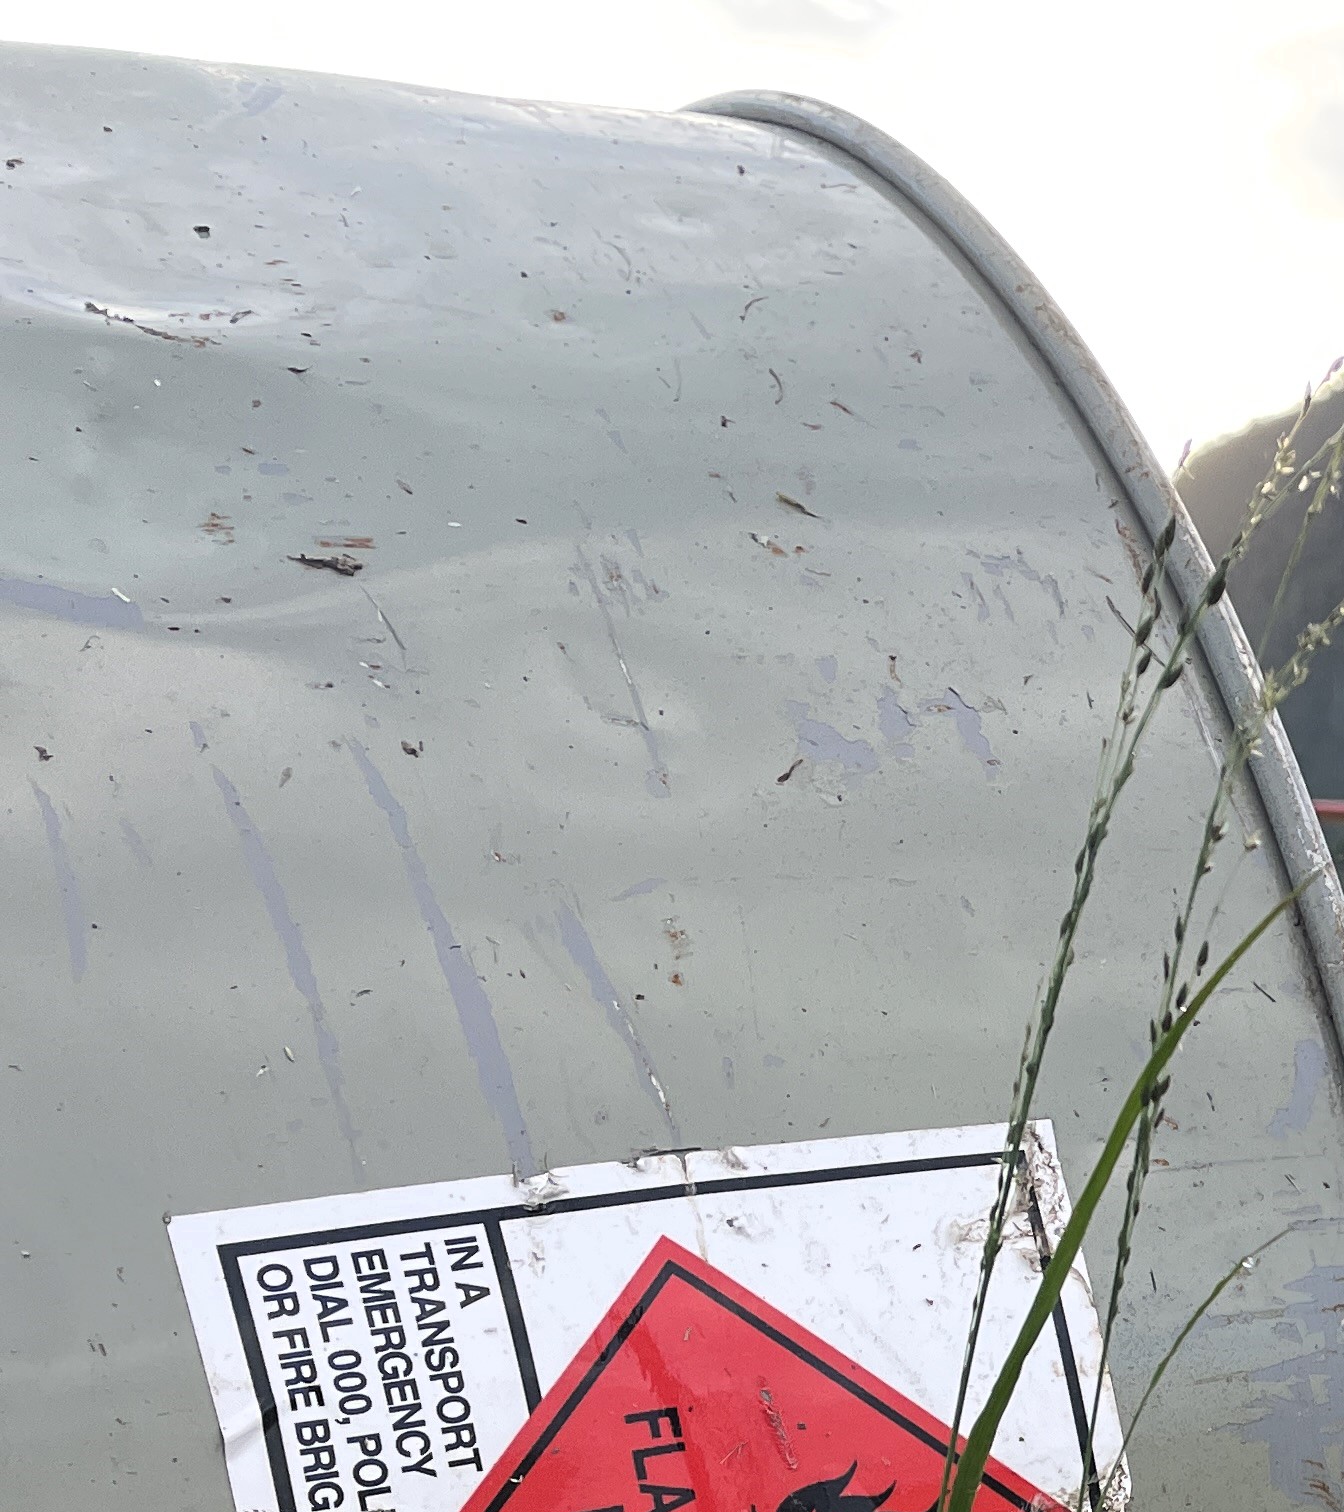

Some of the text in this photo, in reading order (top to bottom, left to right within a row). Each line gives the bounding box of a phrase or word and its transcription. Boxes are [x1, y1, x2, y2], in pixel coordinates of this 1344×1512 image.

[256, 1263, 300, 1320] OR
[444, 1236, 490, 1308] IN A
[272, 1328, 325, 1411] FIRE
[302, 1256, 354, 1344] DIAL
[328, 1350, 372, 1425] 000,
[350, 1248, 437, 1478] EMERGENCY
[400, 1242, 483, 1472] TRANSPORT
